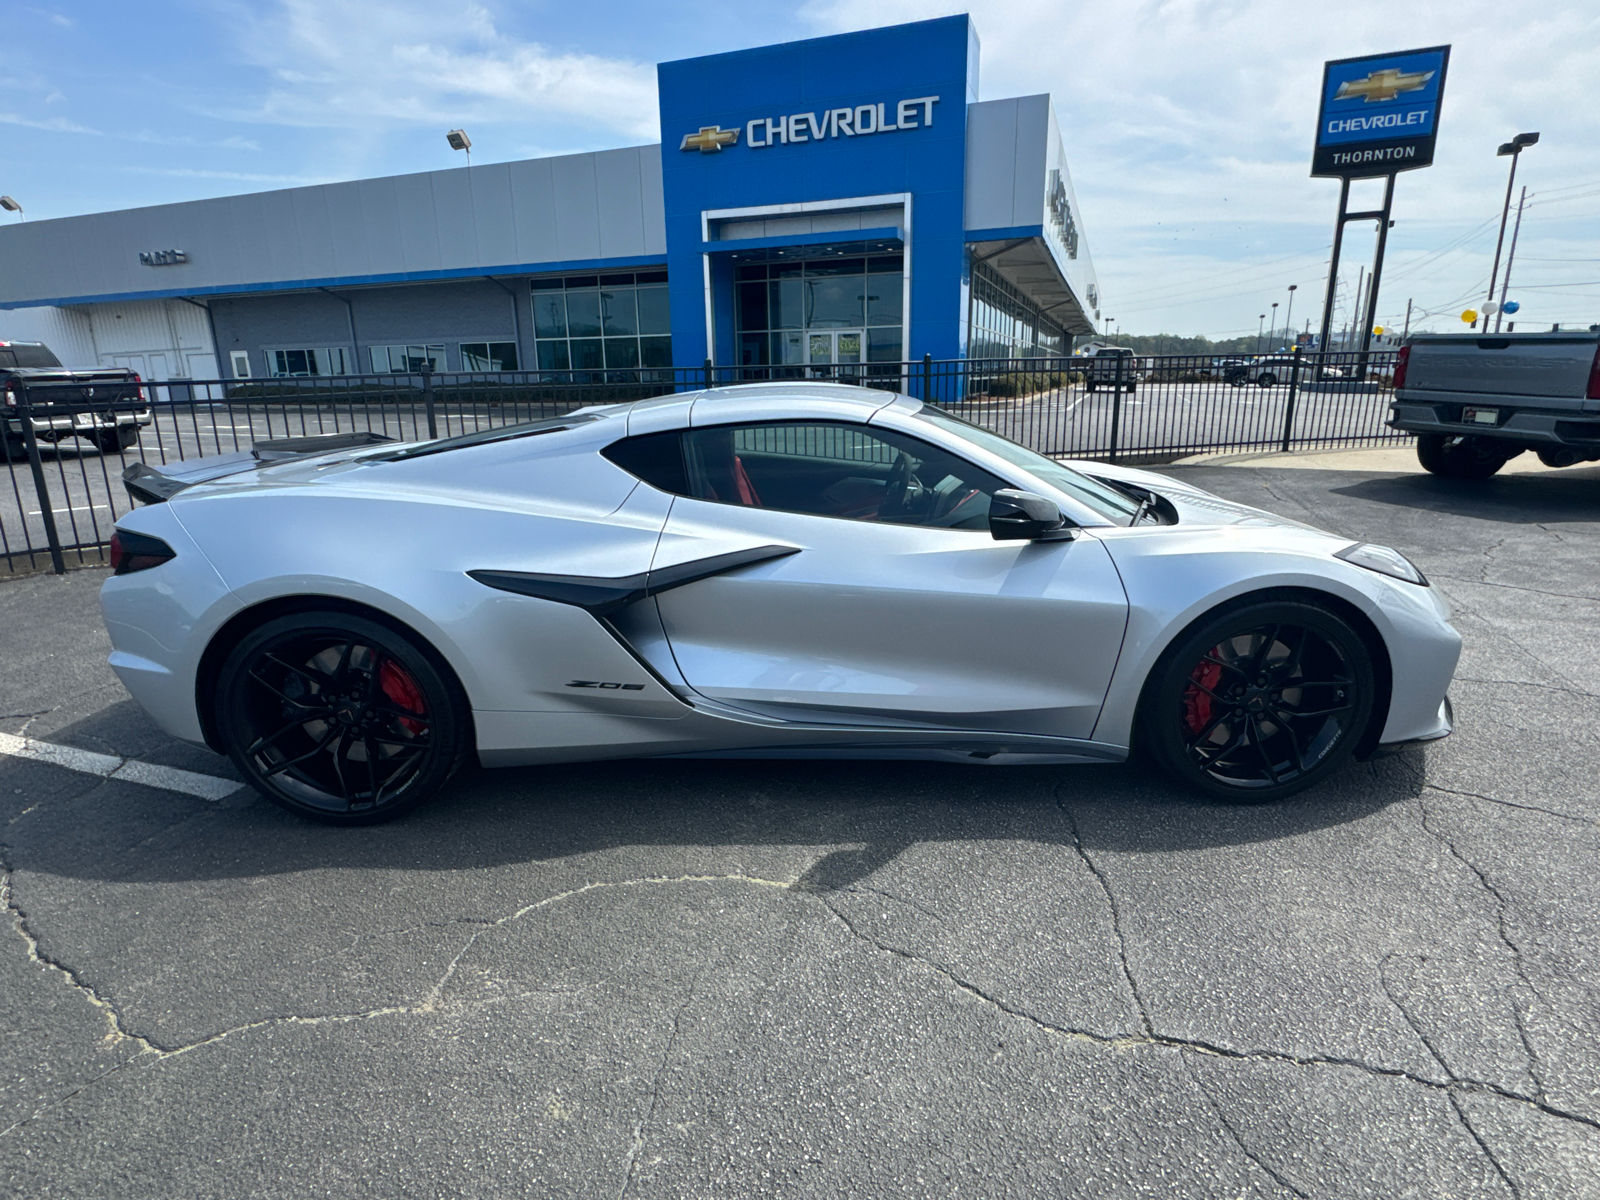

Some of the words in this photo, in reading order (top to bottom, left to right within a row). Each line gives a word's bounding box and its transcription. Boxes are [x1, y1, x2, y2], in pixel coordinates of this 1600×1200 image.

[746, 95, 940, 148] CHEVROLET
[1327, 110, 1429, 134] CHEVROLET
[1332, 146, 1416, 165] THORNTON
[1417, 354, 1577, 369] CHEVROLET
[564, 680, 646, 691] Z06
